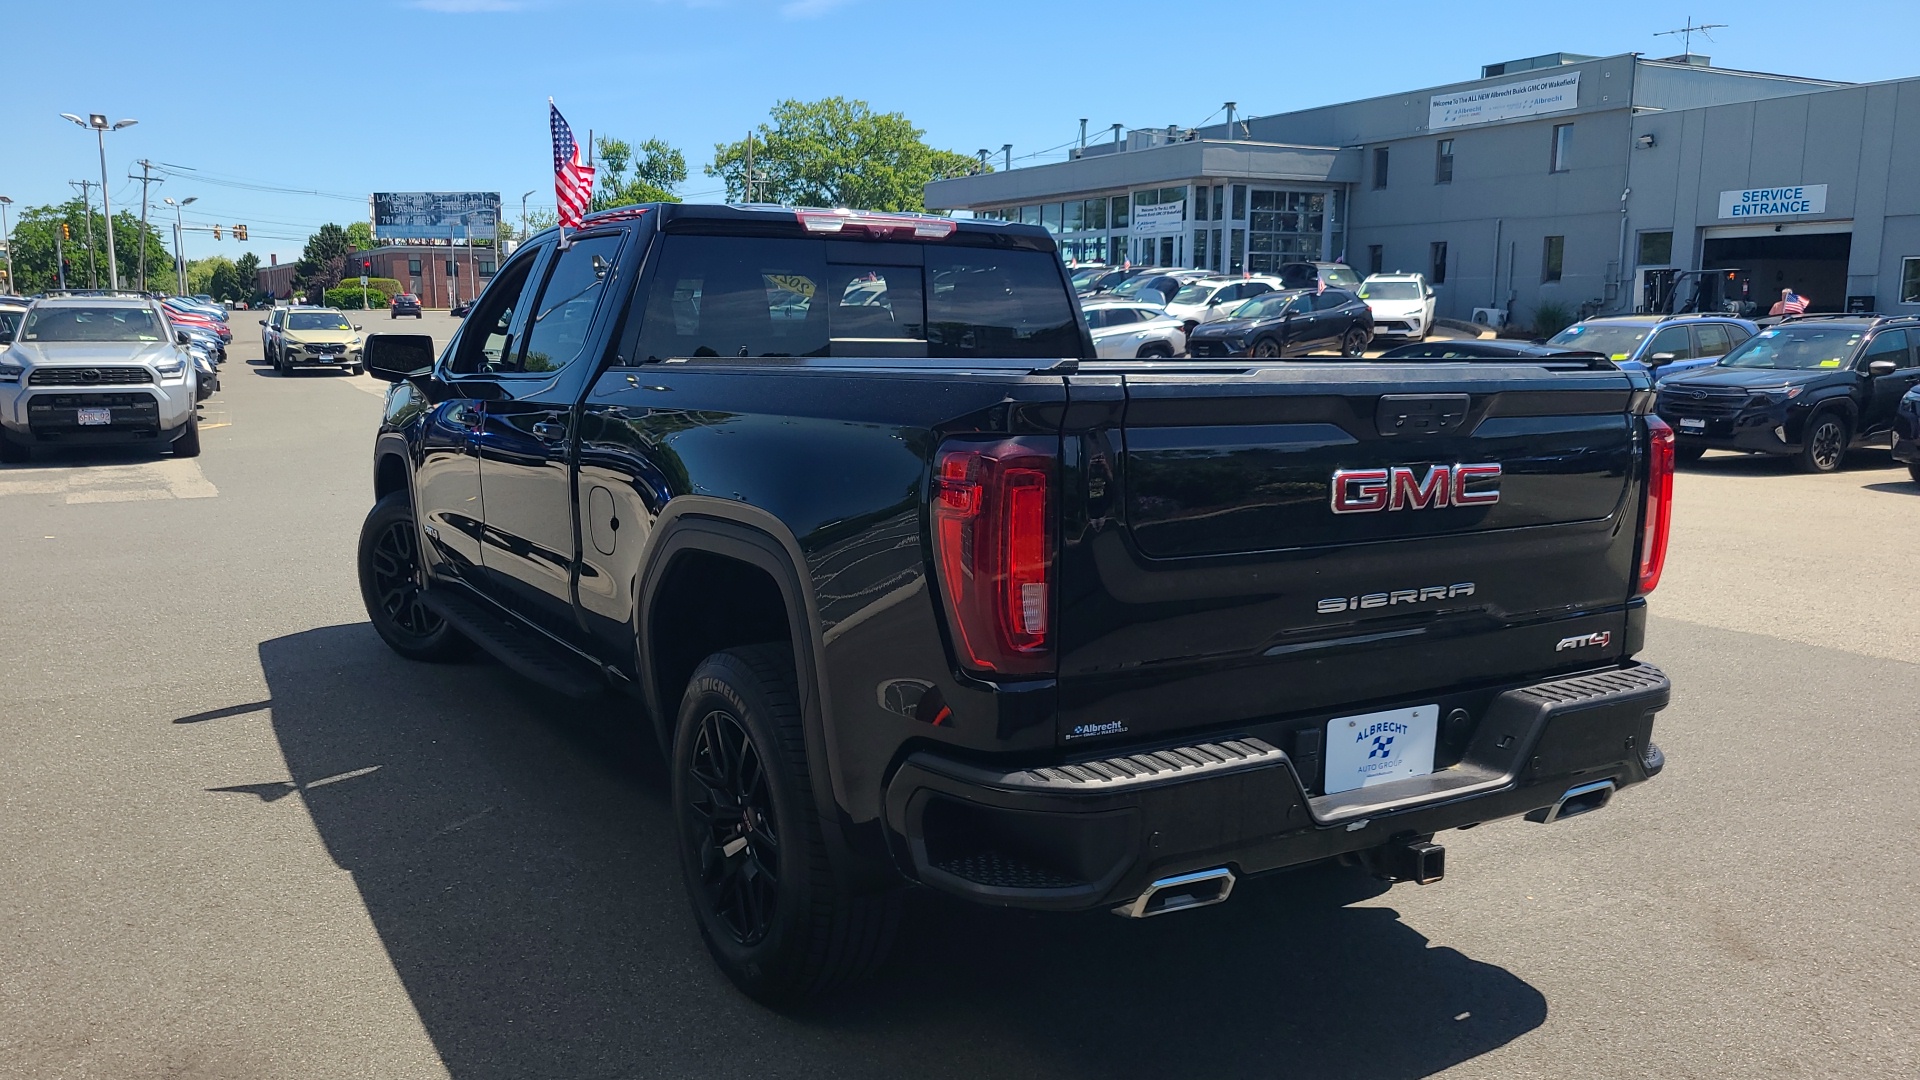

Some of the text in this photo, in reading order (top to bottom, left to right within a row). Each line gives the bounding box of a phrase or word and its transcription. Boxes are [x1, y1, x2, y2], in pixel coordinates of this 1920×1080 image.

[1467, 95, 1477, 103] ALL
[1476, 93, 1491, 101] NEW
[1490, 90, 1512, 100] Albrecht
[1512, 87, 1527, 96] Buick
[1527, 85, 1541, 93] GMC
[1547, 78, 1576, 89] Wakefield
[1534, 95, 1563, 105] Albrecht
[1457, 106, 1482, 114] Albrecht
[376, 194, 412, 203] LAKESIDE
[1742, 187, 1803, 203] SERVICE
[389, 205, 421, 214] LEASING
[1732, 200, 1810, 216] ENTRANCE
[1331, 462, 1502, 515] GMC
[1316, 581, 1476, 615] SIERRA
[1555, 630, 1611, 652] AT4
[701, 677, 747, 716] MICHELIN
[1082, 720, 1122, 734] Albrecht
[1355, 721, 1408, 744] ALBRECHT
[1357, 763, 1377, 774] AUTO
[1378, 759, 1403, 770] GROUP
